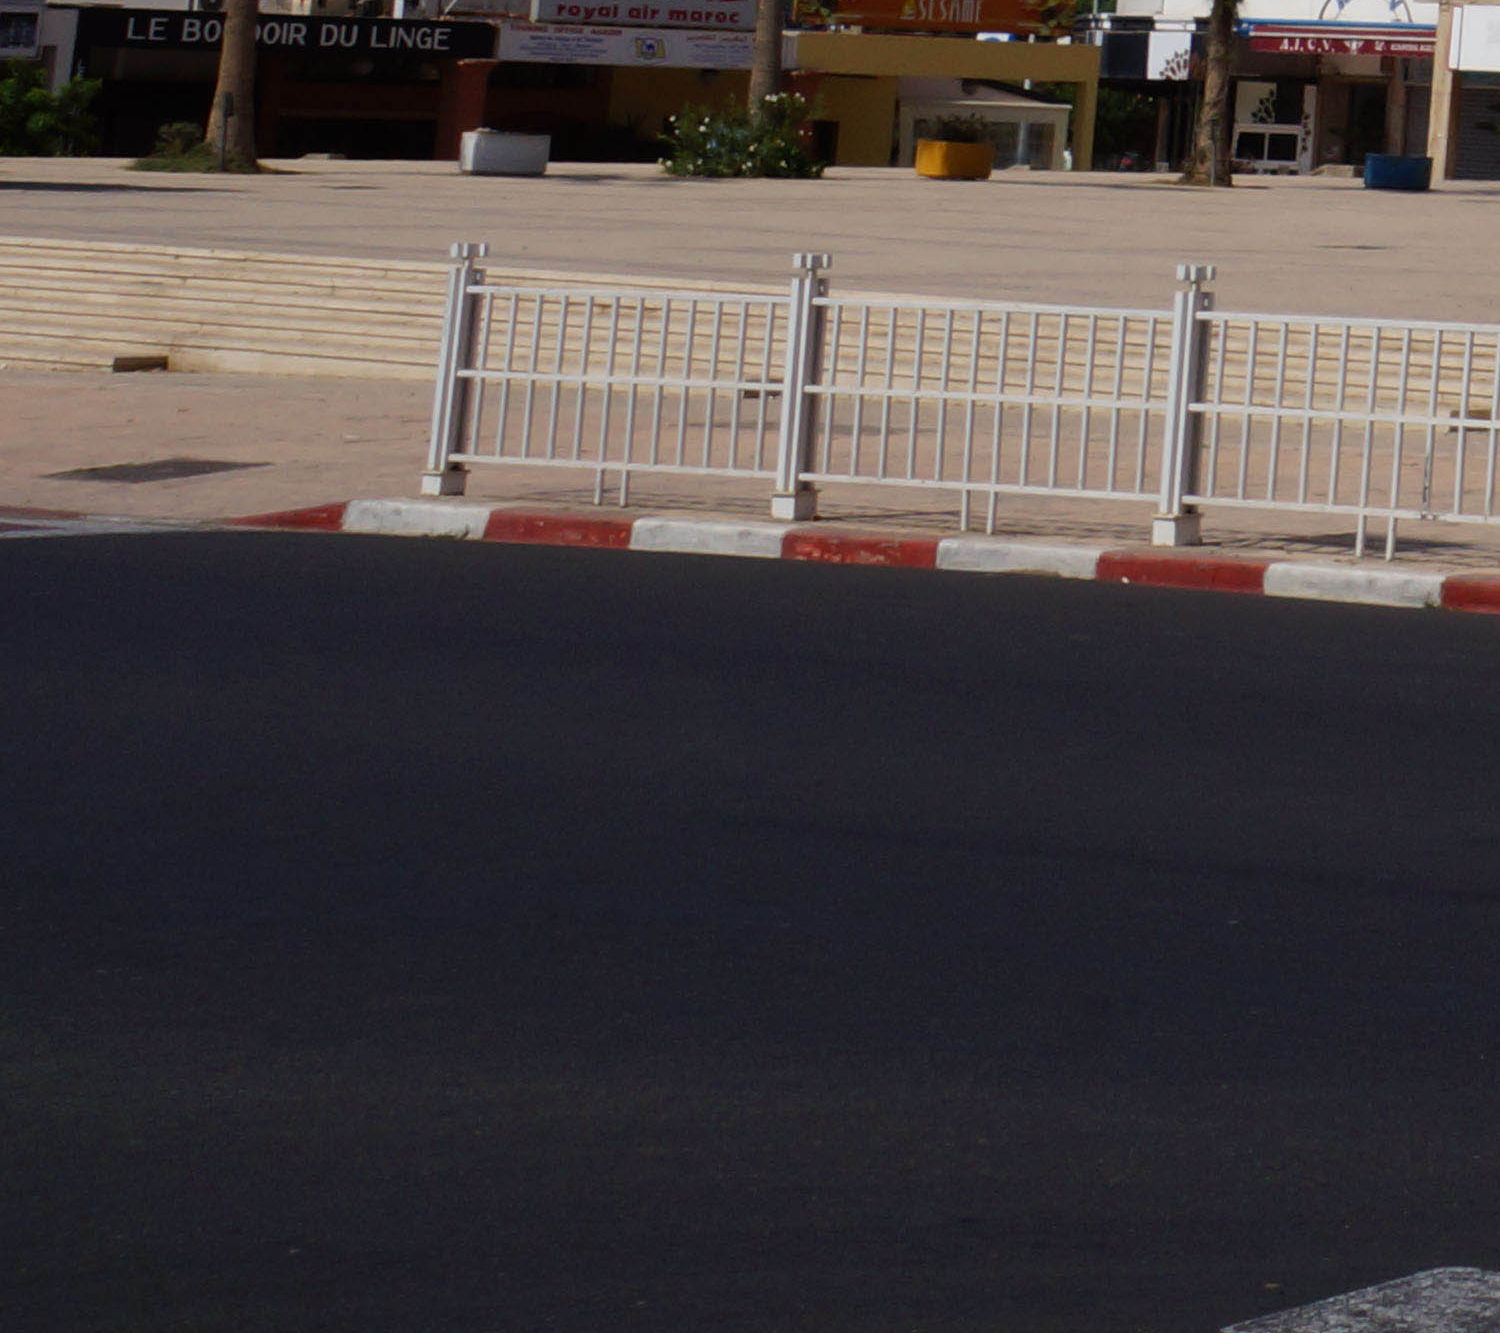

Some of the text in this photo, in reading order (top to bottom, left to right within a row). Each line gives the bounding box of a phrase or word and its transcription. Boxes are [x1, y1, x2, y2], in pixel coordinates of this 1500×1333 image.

[556, 3, 741, 24] royal air maroc
[126, 17, 451, 52] LE BOOIR DU LINGE
